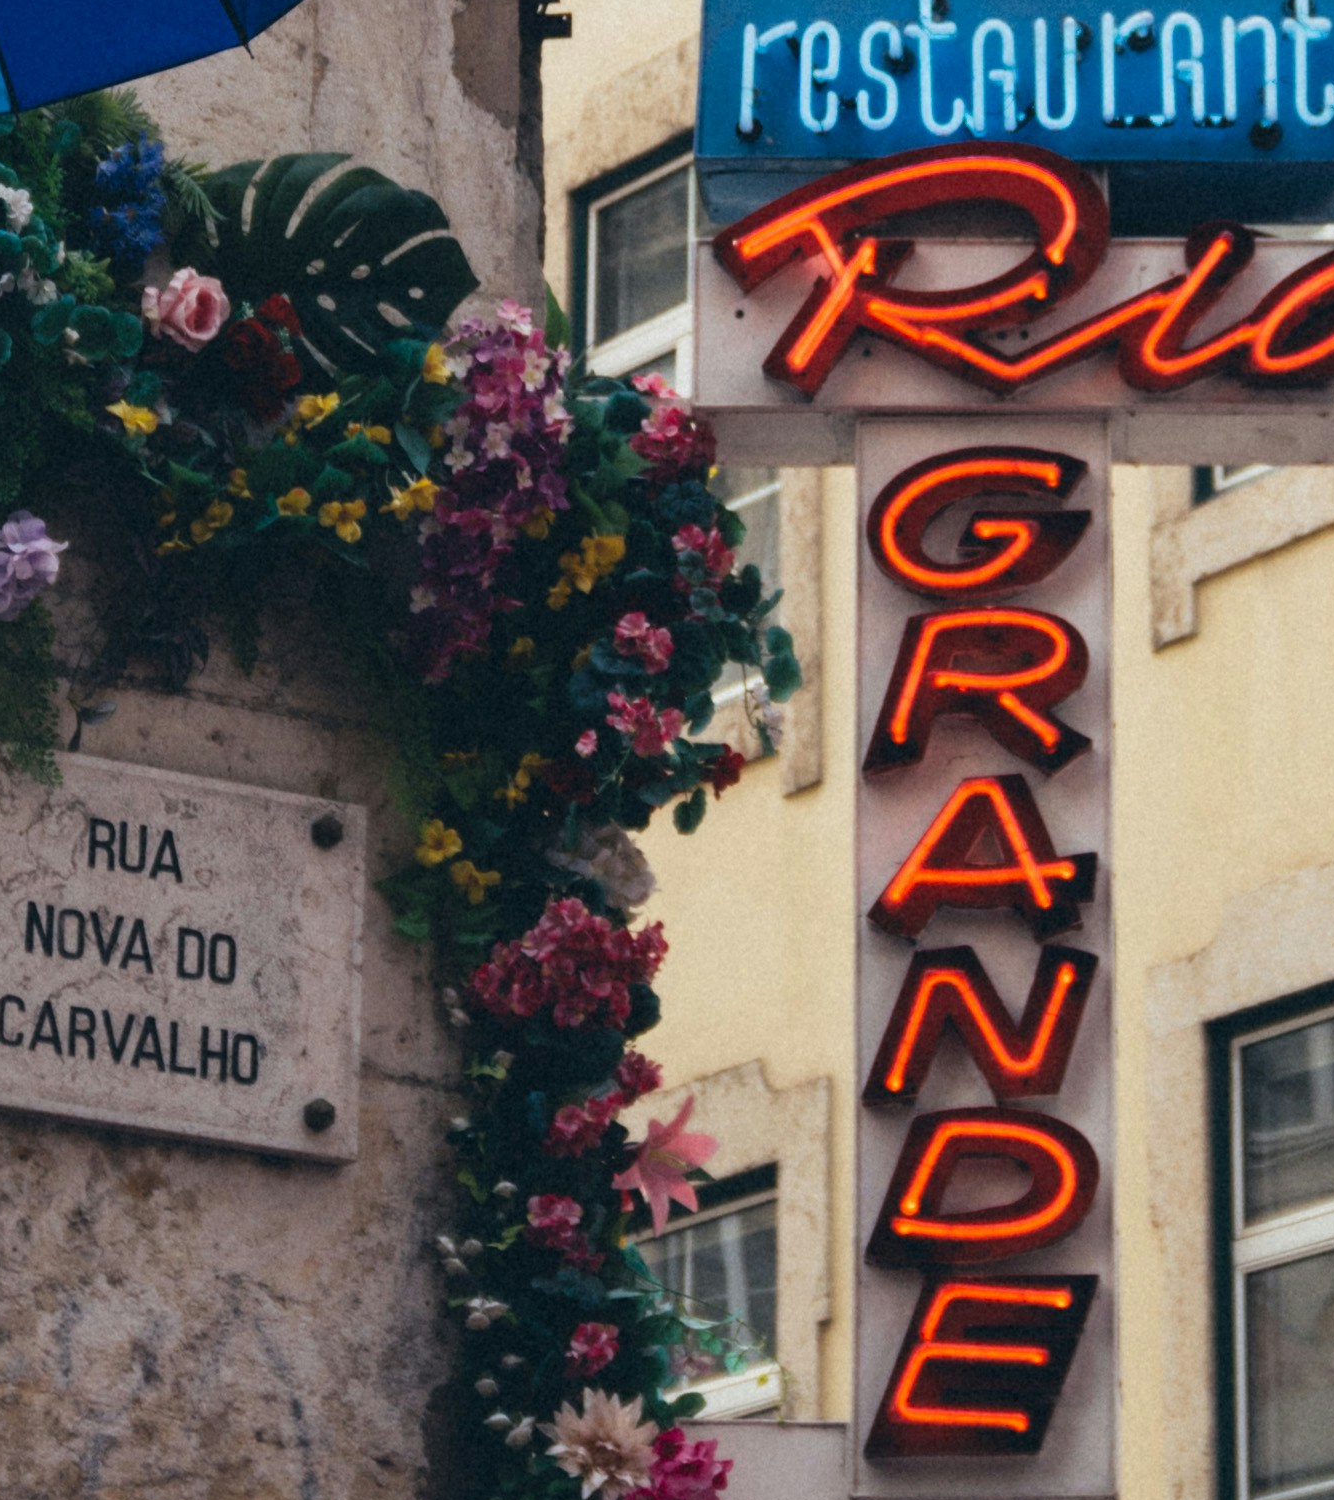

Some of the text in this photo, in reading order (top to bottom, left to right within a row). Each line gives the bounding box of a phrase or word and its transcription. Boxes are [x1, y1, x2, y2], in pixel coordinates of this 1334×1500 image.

[86, 816, 184, 884] RUA
[23, 900, 238, 986] NOVA DO
[862, 445, 1099, 1458] GRANDE
